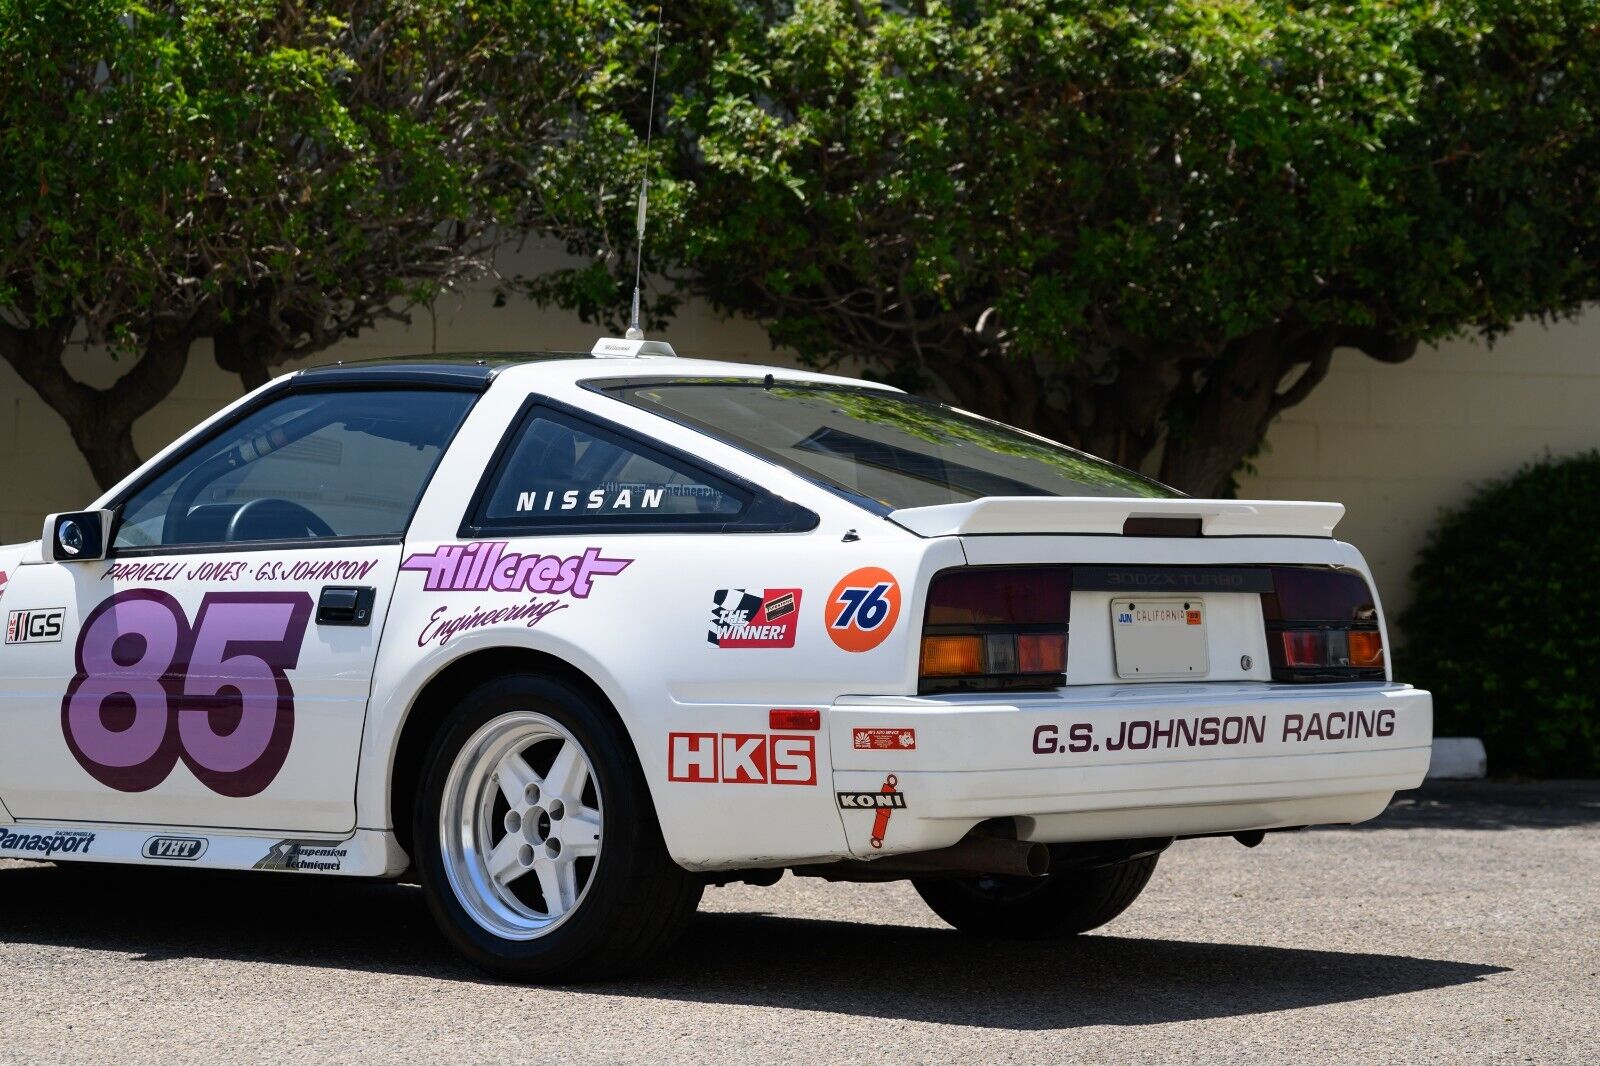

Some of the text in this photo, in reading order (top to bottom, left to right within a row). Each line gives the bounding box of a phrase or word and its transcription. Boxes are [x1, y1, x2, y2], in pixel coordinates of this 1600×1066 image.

[516, 489, 663, 512] NISSAN
[101, 562, 188, 581] PARNELLI
[187, 561, 248, 581] JONES
[400, 541, 635, 598] Hillcrest
[719, 609, 750, 626] THE
[830, 582, 893, 632] 76
[1118, 613, 1133, 623] JUN
[1136, 610, 1185, 622] CALIFORNIA
[30, 613, 62, 637] GS
[417, 596, 569, 648] Engineering
[716, 624, 787, 640] WINNER!
[61, 588, 314, 798] 85
[1282, 709, 1396, 742] RACING
[668, 733, 817, 786] HKS
[840, 794, 904, 808] KONI
[157, 839, 197, 856] VHT
[289, 843, 348, 857] Suspension
[285, 855, 341, 871] Techniques
